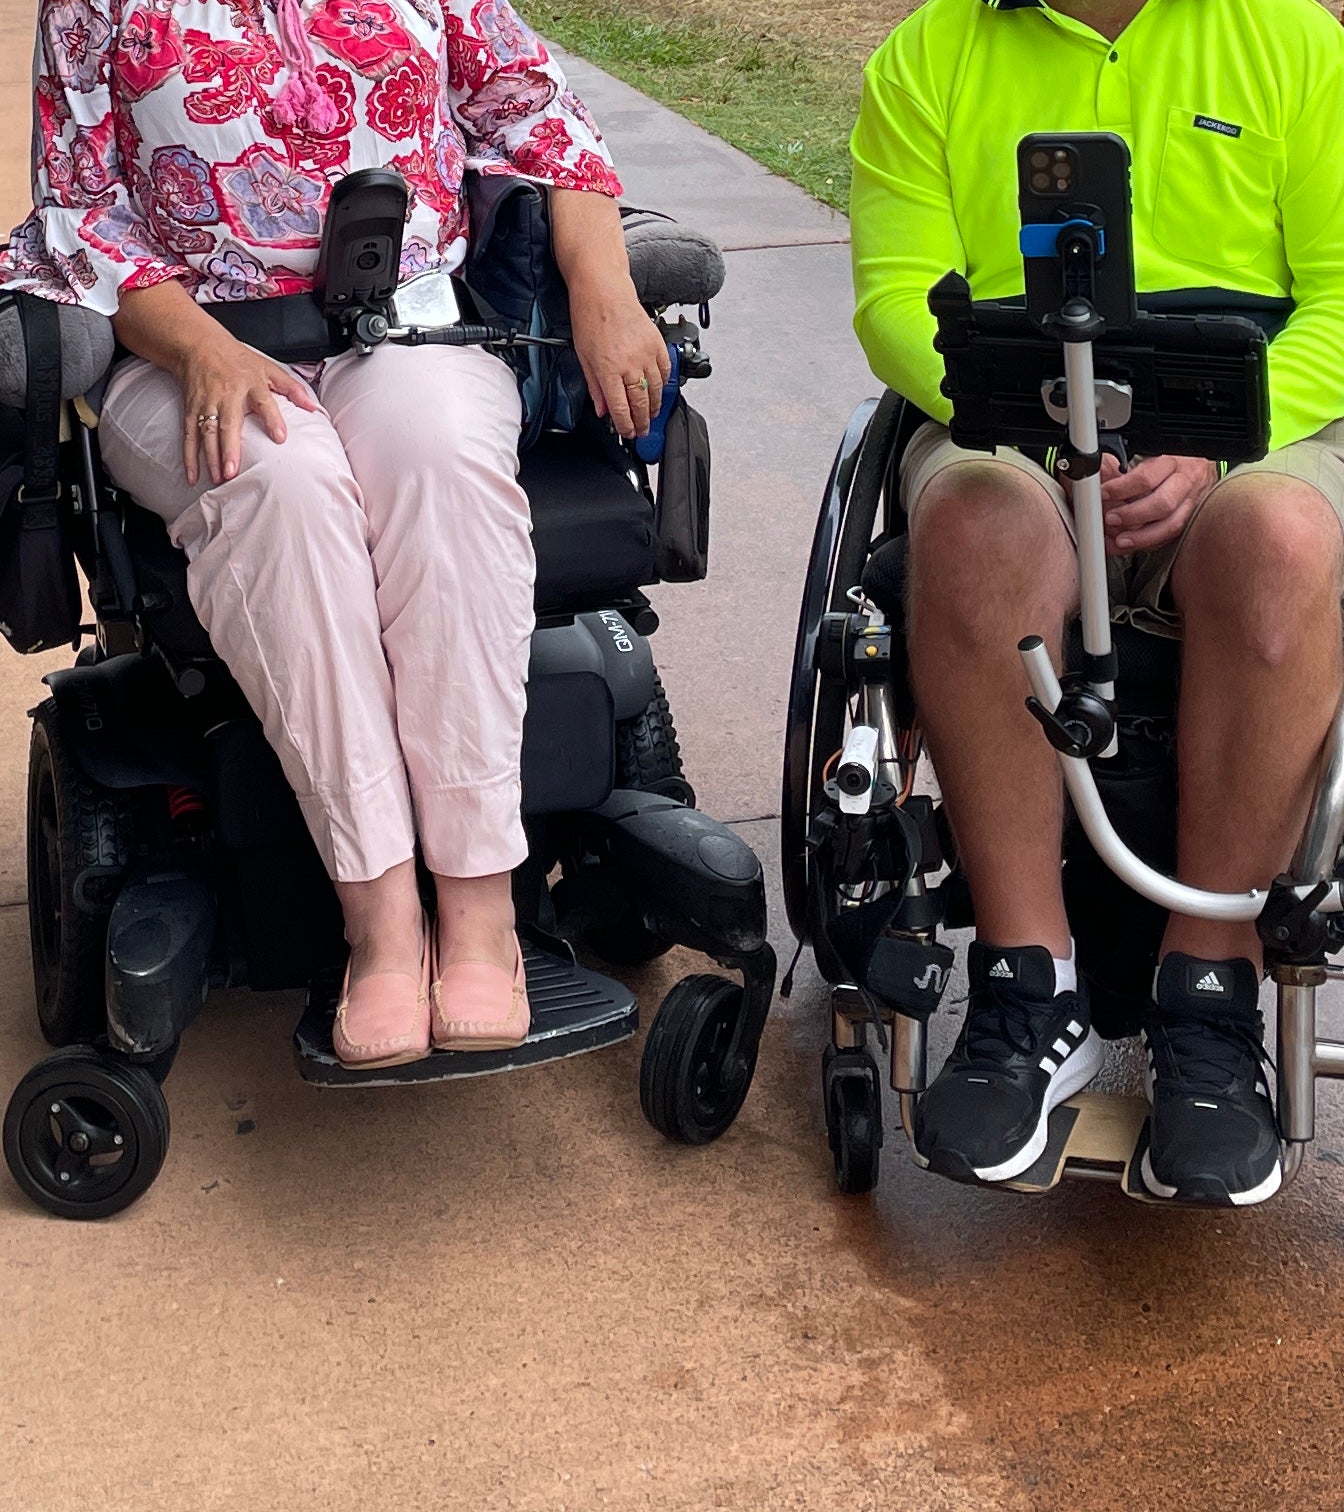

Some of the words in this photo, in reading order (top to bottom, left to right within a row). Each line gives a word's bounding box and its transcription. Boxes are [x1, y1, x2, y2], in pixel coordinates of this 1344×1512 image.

[596, 610, 634, 653] QM-71
[989, 969, 1014, 978] adidas
[1196, 982, 1224, 992] adidas
